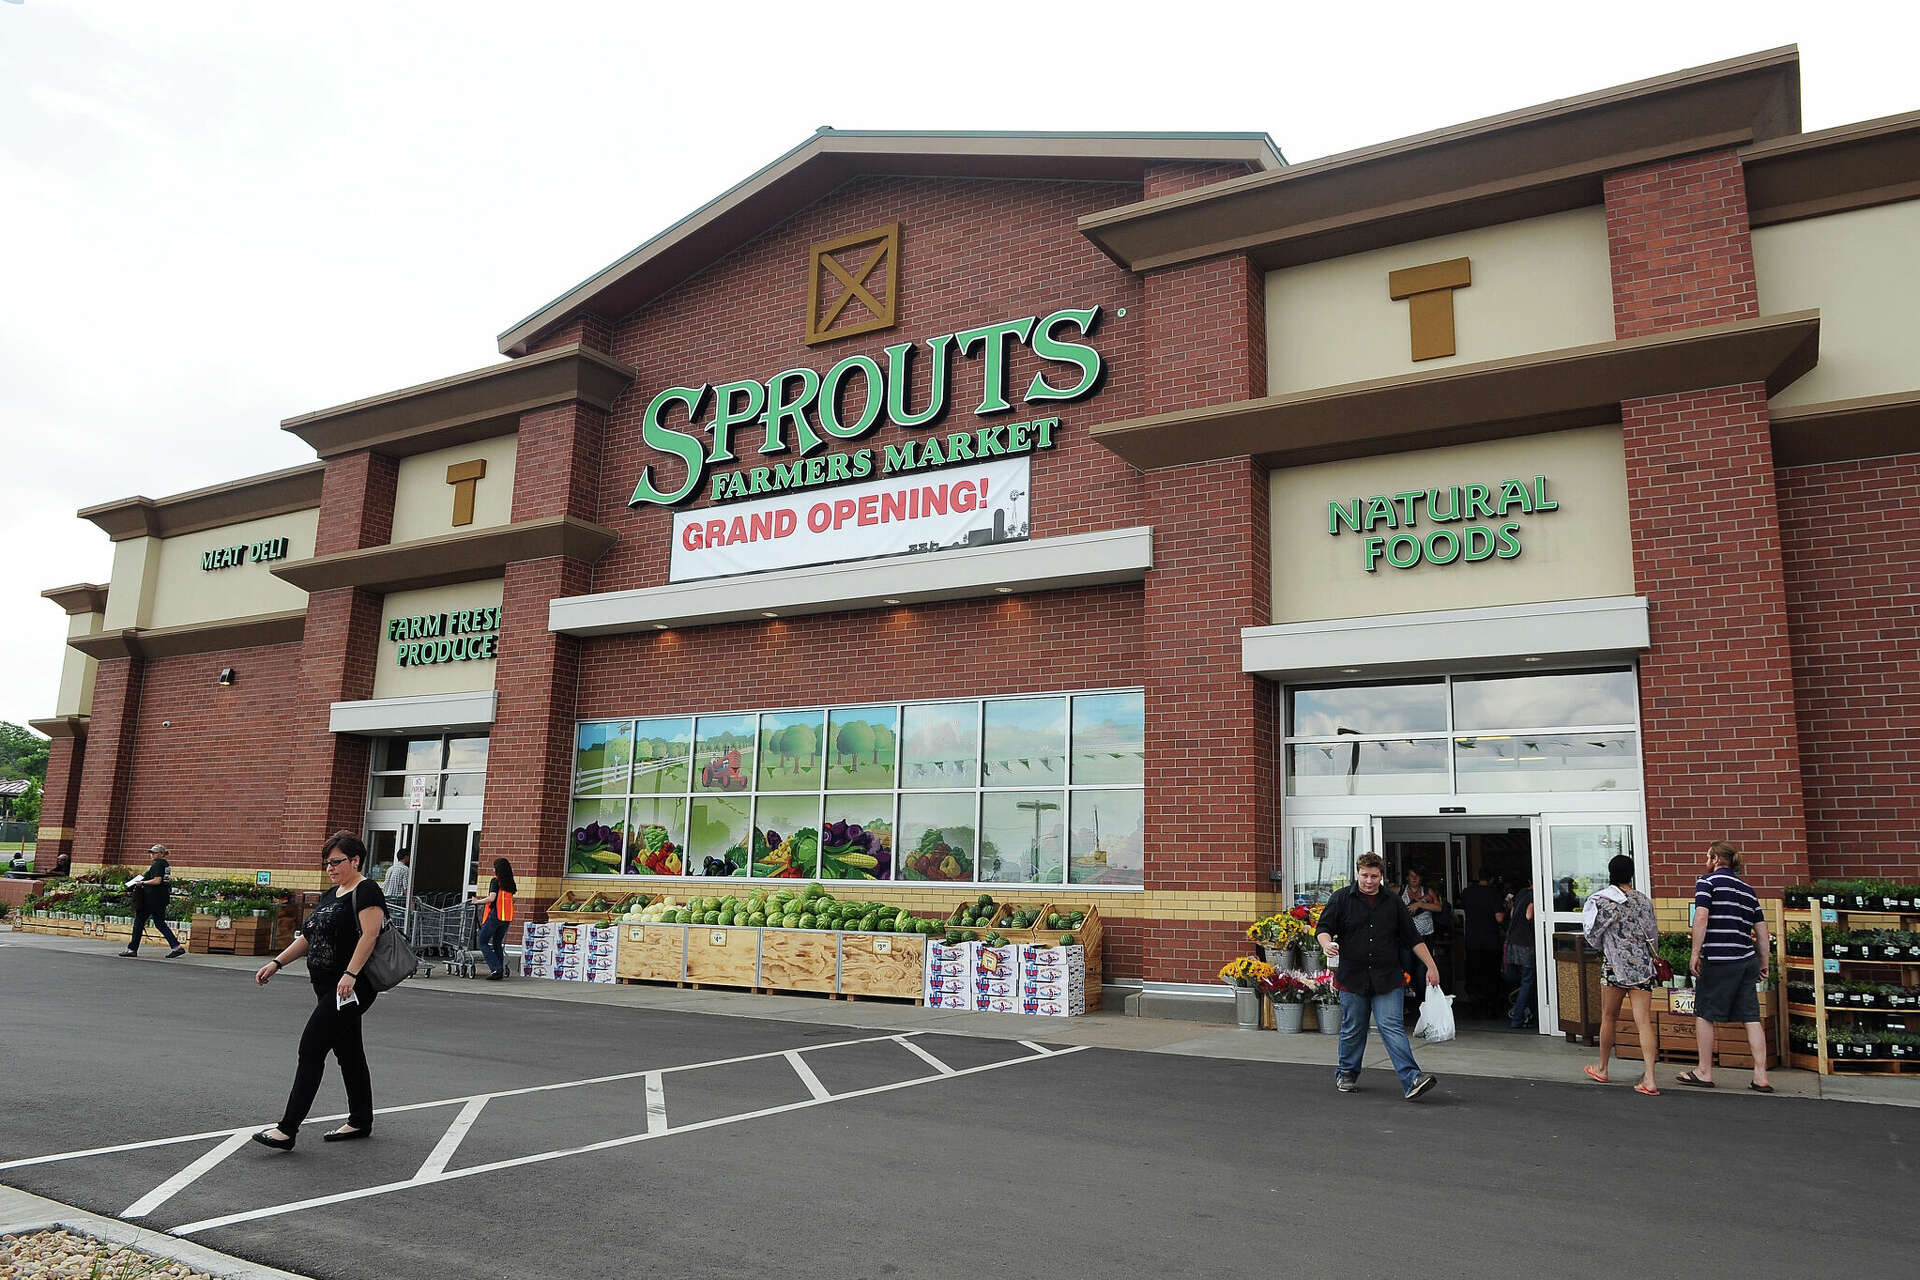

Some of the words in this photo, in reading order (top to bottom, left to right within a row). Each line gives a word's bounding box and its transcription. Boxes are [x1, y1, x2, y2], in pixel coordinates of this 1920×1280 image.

[628, 304, 1103, 506] SPROUTS
[710, 449, 873, 500] FARMERS
[882, 416, 1059, 472] MARKET
[682, 508, 798, 552] GRAND
[807, 477, 989, 534] OPENING!
[1328, 475, 1559, 534] NATURAL
[200, 545, 247, 571] MEAT
[249, 536, 288, 563] DELI
[1364, 522, 1522, 572] FOODS
[387, 615, 445, 641] FARM
[397, 635, 496, 666] PRODUCE
